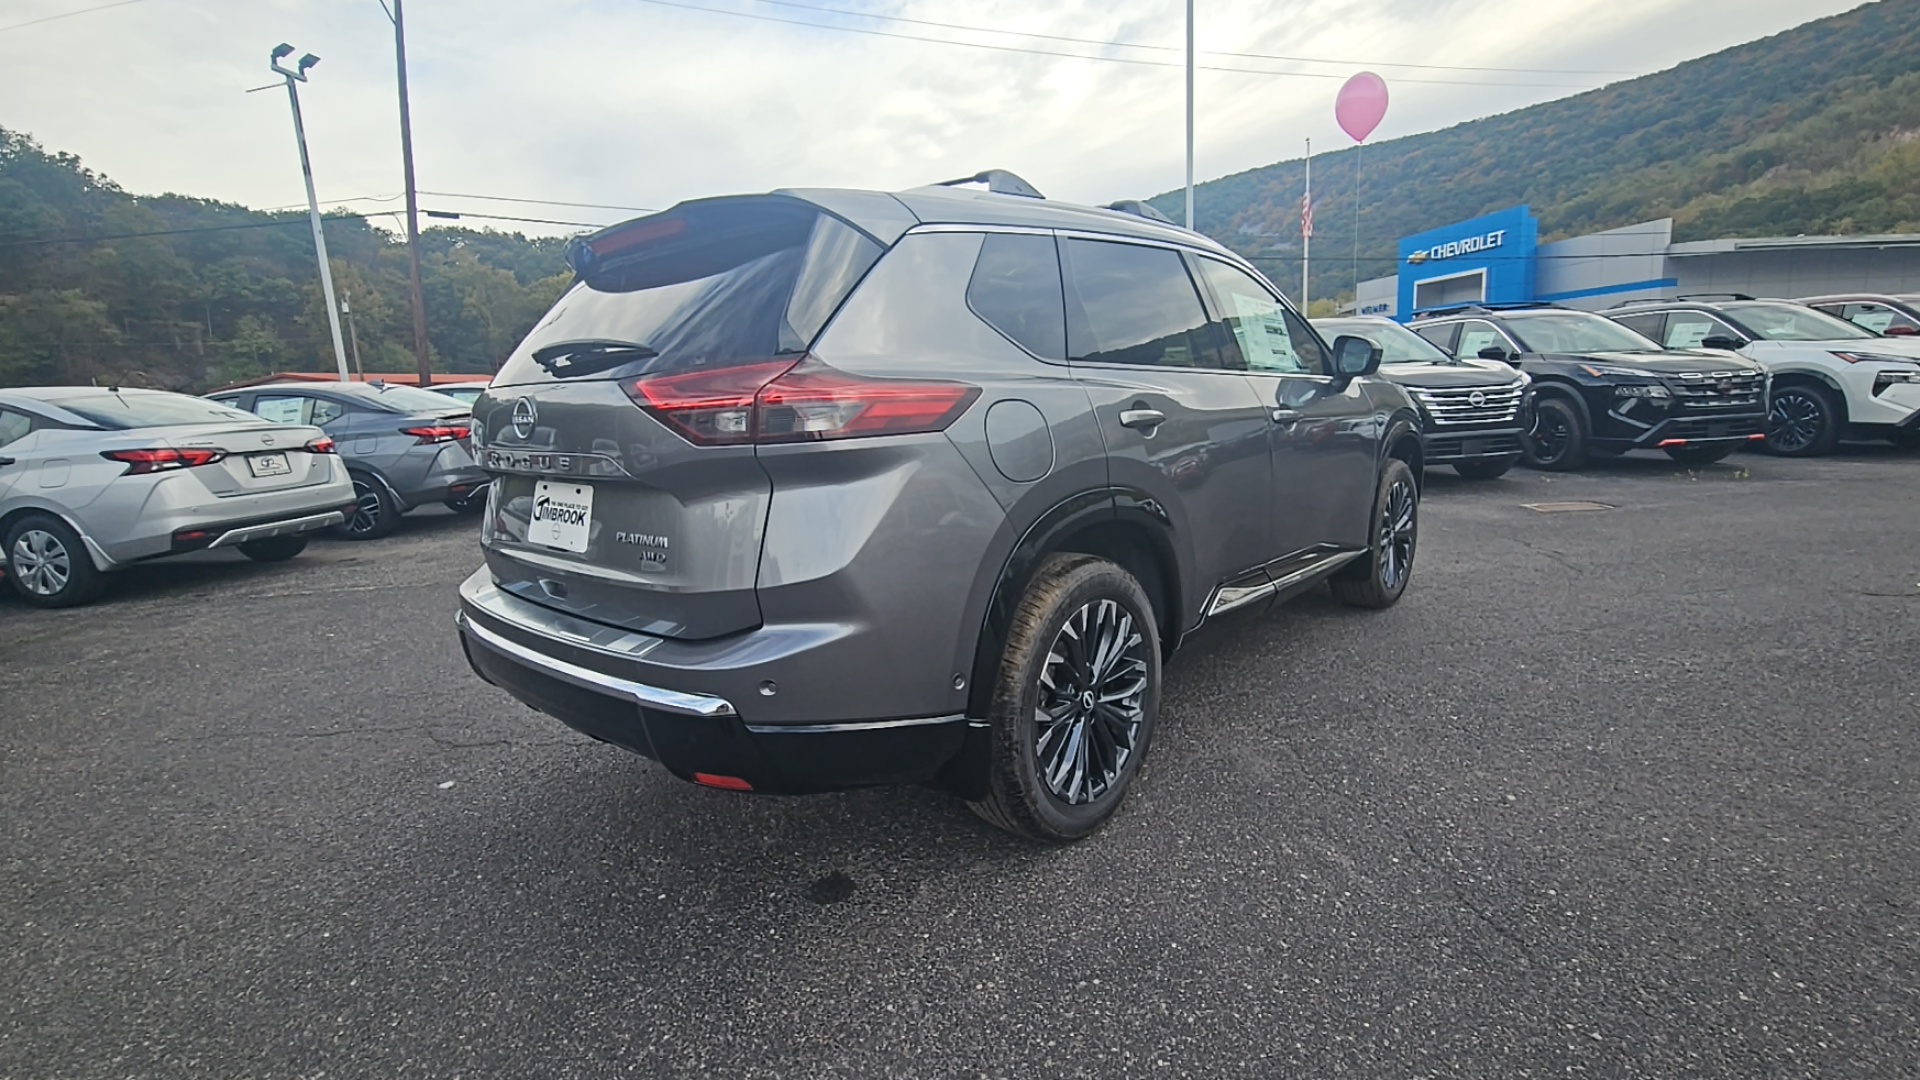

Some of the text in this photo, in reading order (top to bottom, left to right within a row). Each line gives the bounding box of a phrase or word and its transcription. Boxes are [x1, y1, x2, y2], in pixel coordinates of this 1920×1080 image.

[1430, 230, 1505, 259] CHEVROLET
[512, 416, 534, 424] NISSAN
[488, 451, 571, 470] ROGUE
[616, 531, 669, 548] PLATINUM
[640, 551, 667, 563] AWD
